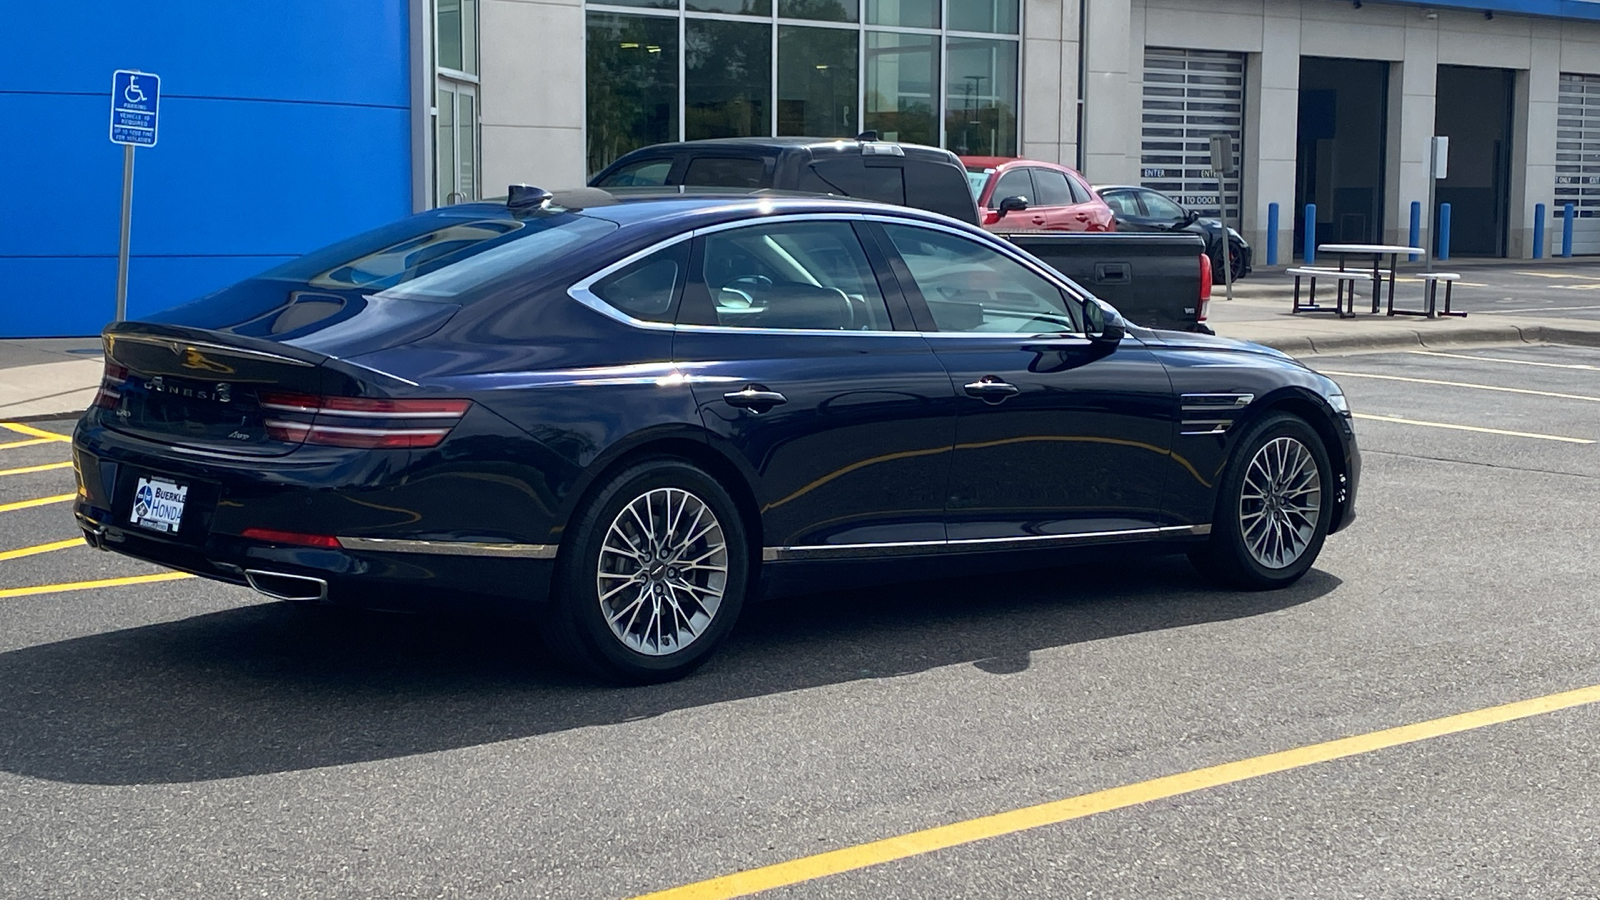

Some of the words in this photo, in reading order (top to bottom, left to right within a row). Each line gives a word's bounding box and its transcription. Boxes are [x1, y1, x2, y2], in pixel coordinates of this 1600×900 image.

[123, 102, 147, 110] PARKING
[120, 112, 141, 120] VEHICLE
[121, 118, 148, 127] REQUIRED
[1144, 169, 1165, 177] ENTER
[1201, 169, 1218, 178] ENTE
[1186, 196, 1195, 204] TO
[144, 380, 231, 402] GENESIS
[155, 487, 186, 502] BUERKLE
[151, 499, 183, 521] HONDA
